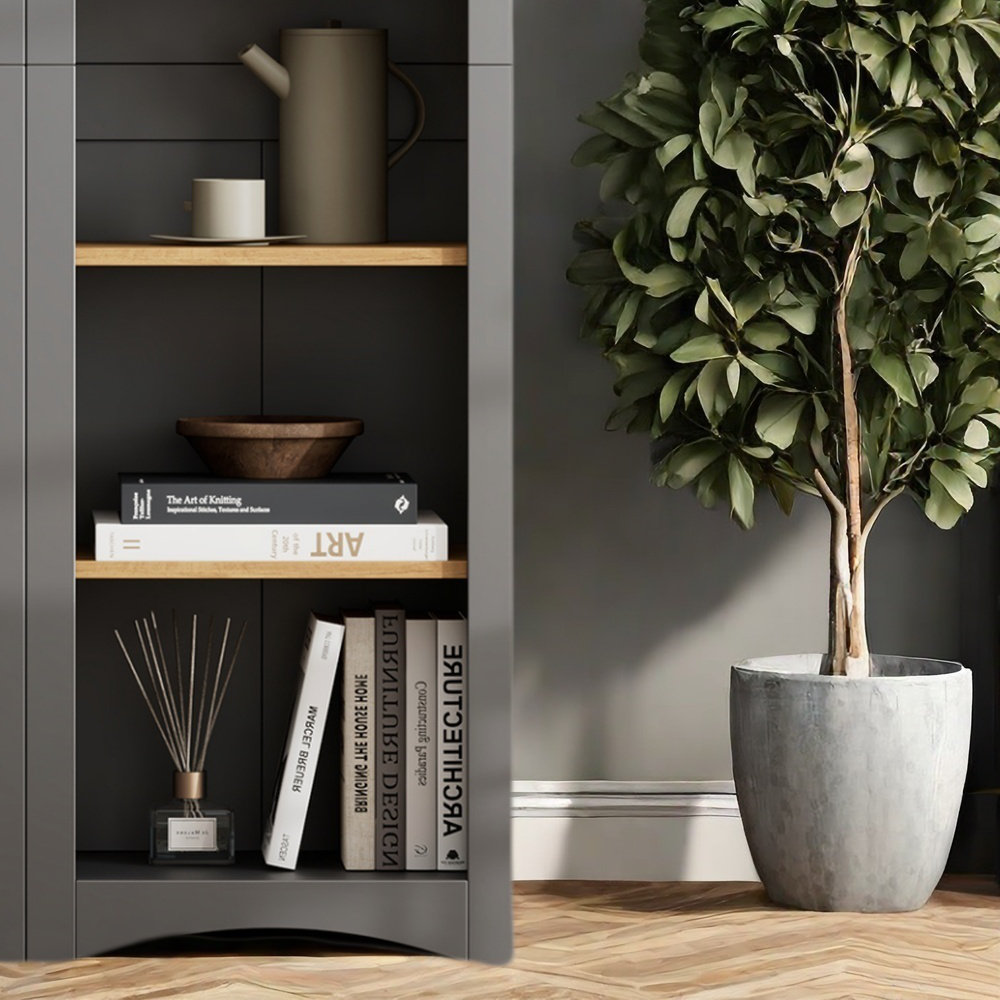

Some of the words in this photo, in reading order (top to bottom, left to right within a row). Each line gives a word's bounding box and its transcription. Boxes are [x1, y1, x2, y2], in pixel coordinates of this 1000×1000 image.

[166, 495, 182, 504] The
[184, 495, 198, 504] Art
[199, 495, 208, 504] of
[209, 495, 242, 507] Knitting
[310, 532, 364, 557] ART
